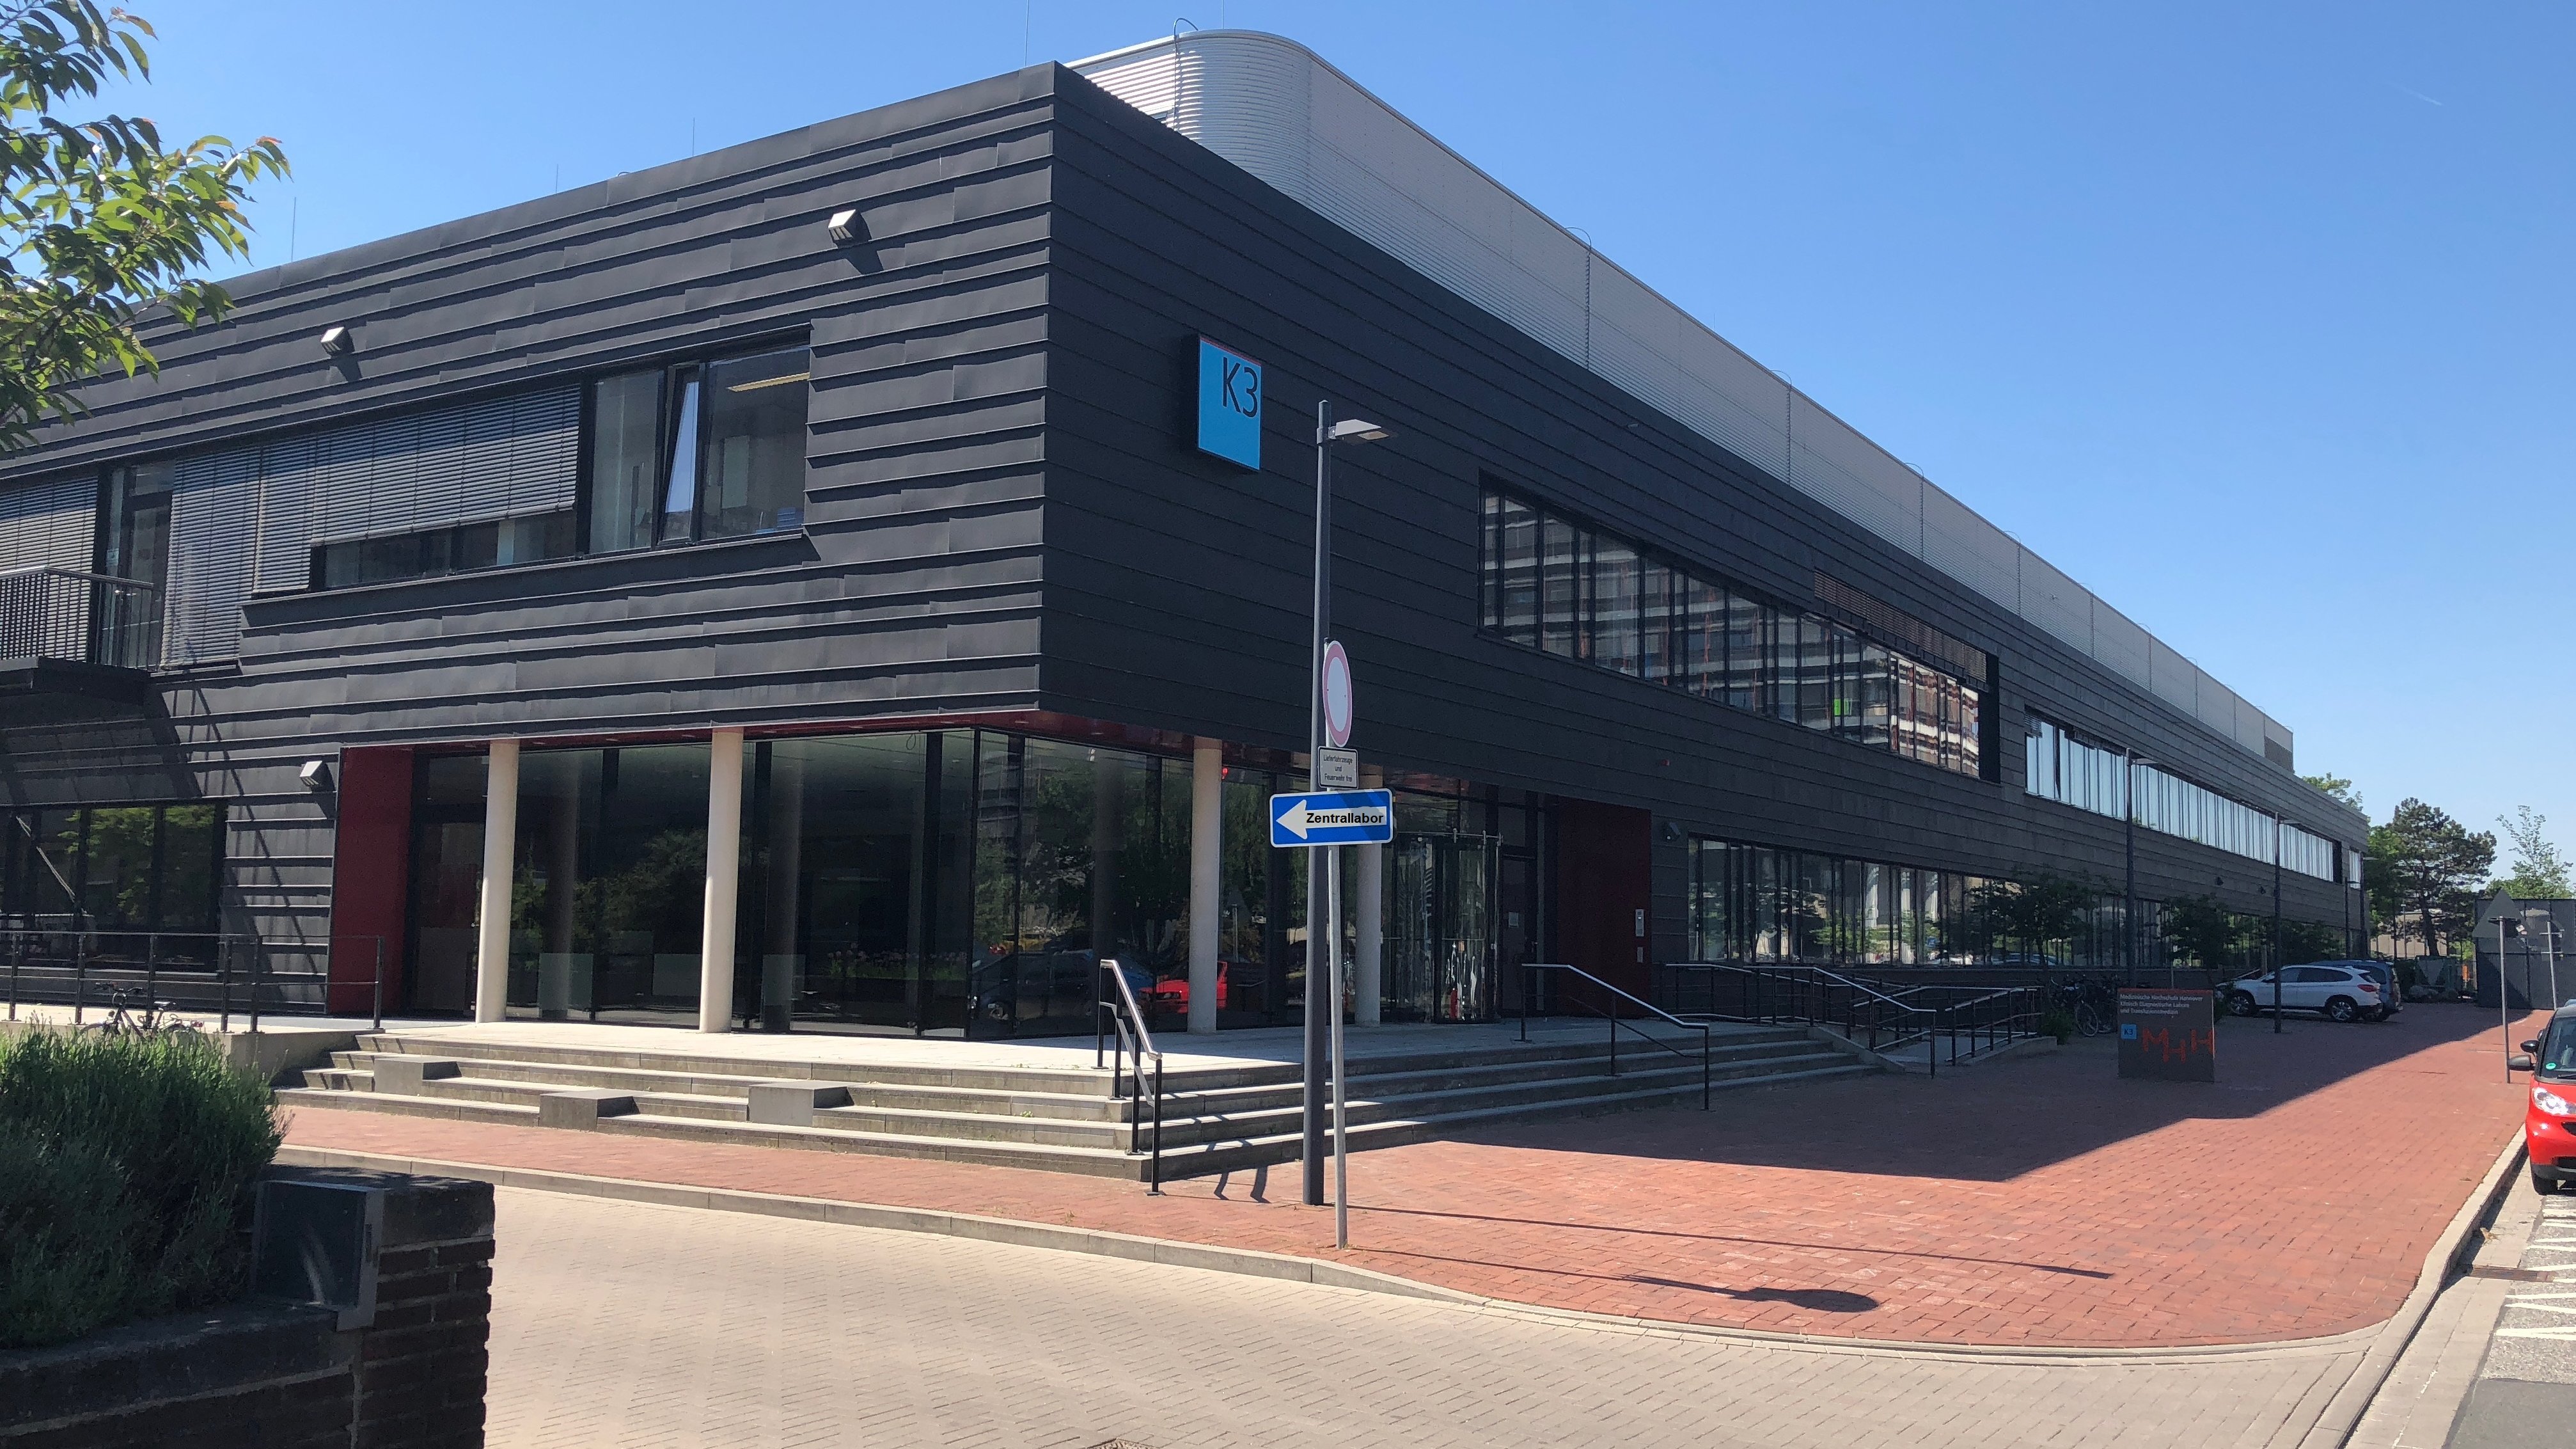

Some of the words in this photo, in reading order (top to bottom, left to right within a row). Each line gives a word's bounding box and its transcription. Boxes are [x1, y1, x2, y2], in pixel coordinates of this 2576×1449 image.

[1223, 356, 1258, 418] K3
[1323, 754, 1353, 764] Lieferfahrzeuge
[1324, 773, 1345, 781] Feuerwehr
[1306, 812, 1384, 823] Zentrallabor
